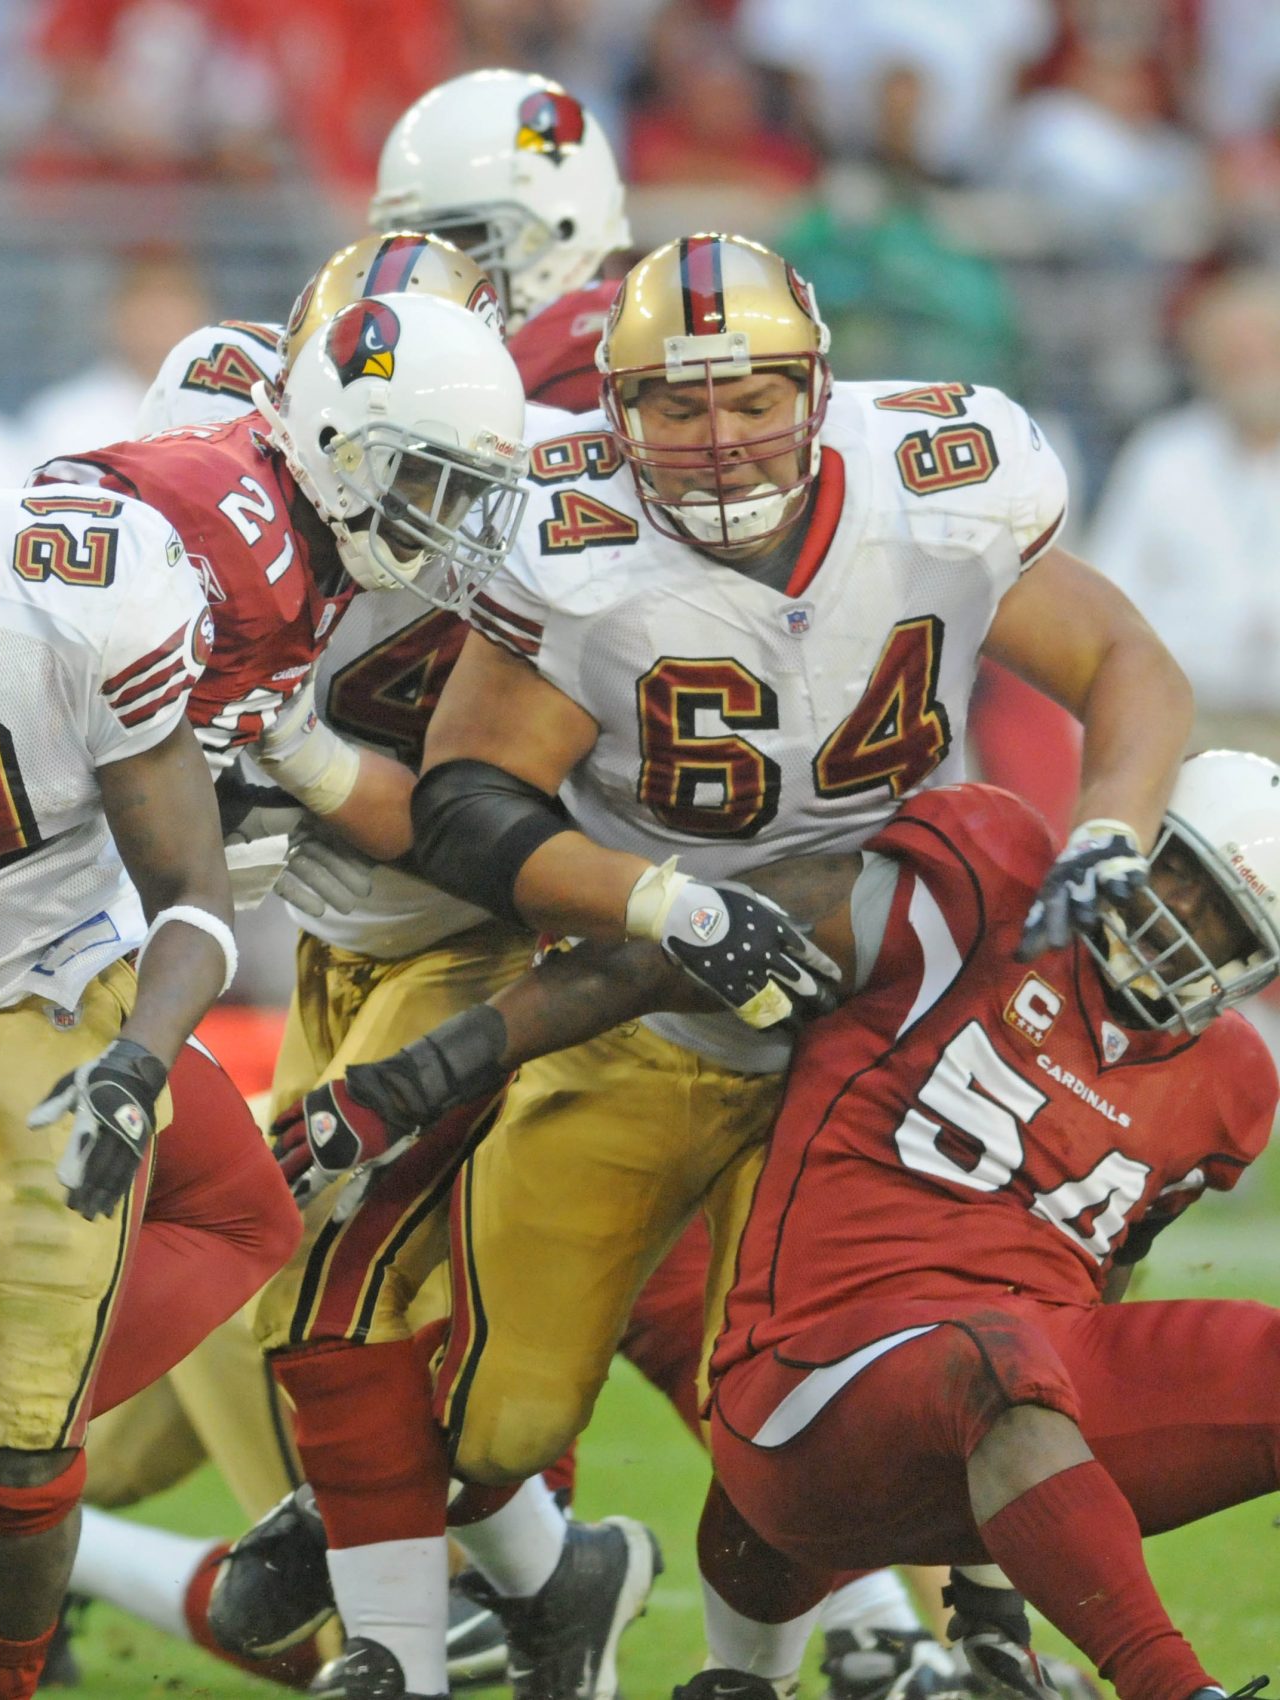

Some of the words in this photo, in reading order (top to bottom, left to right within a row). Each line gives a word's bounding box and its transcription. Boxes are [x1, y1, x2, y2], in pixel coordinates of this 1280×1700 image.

[872, 381, 1001, 498] 64
[12, 496, 125, 589] 21
[526, 430, 639, 556] 64
[634, 604, 953, 841] 64
[1230, 854, 1267, 897] Riddell
[1013, 978, 1061, 1031] C
[894, 1019, 1154, 1268] 54
[1036, 1053, 1132, 1129] CARDINALS
